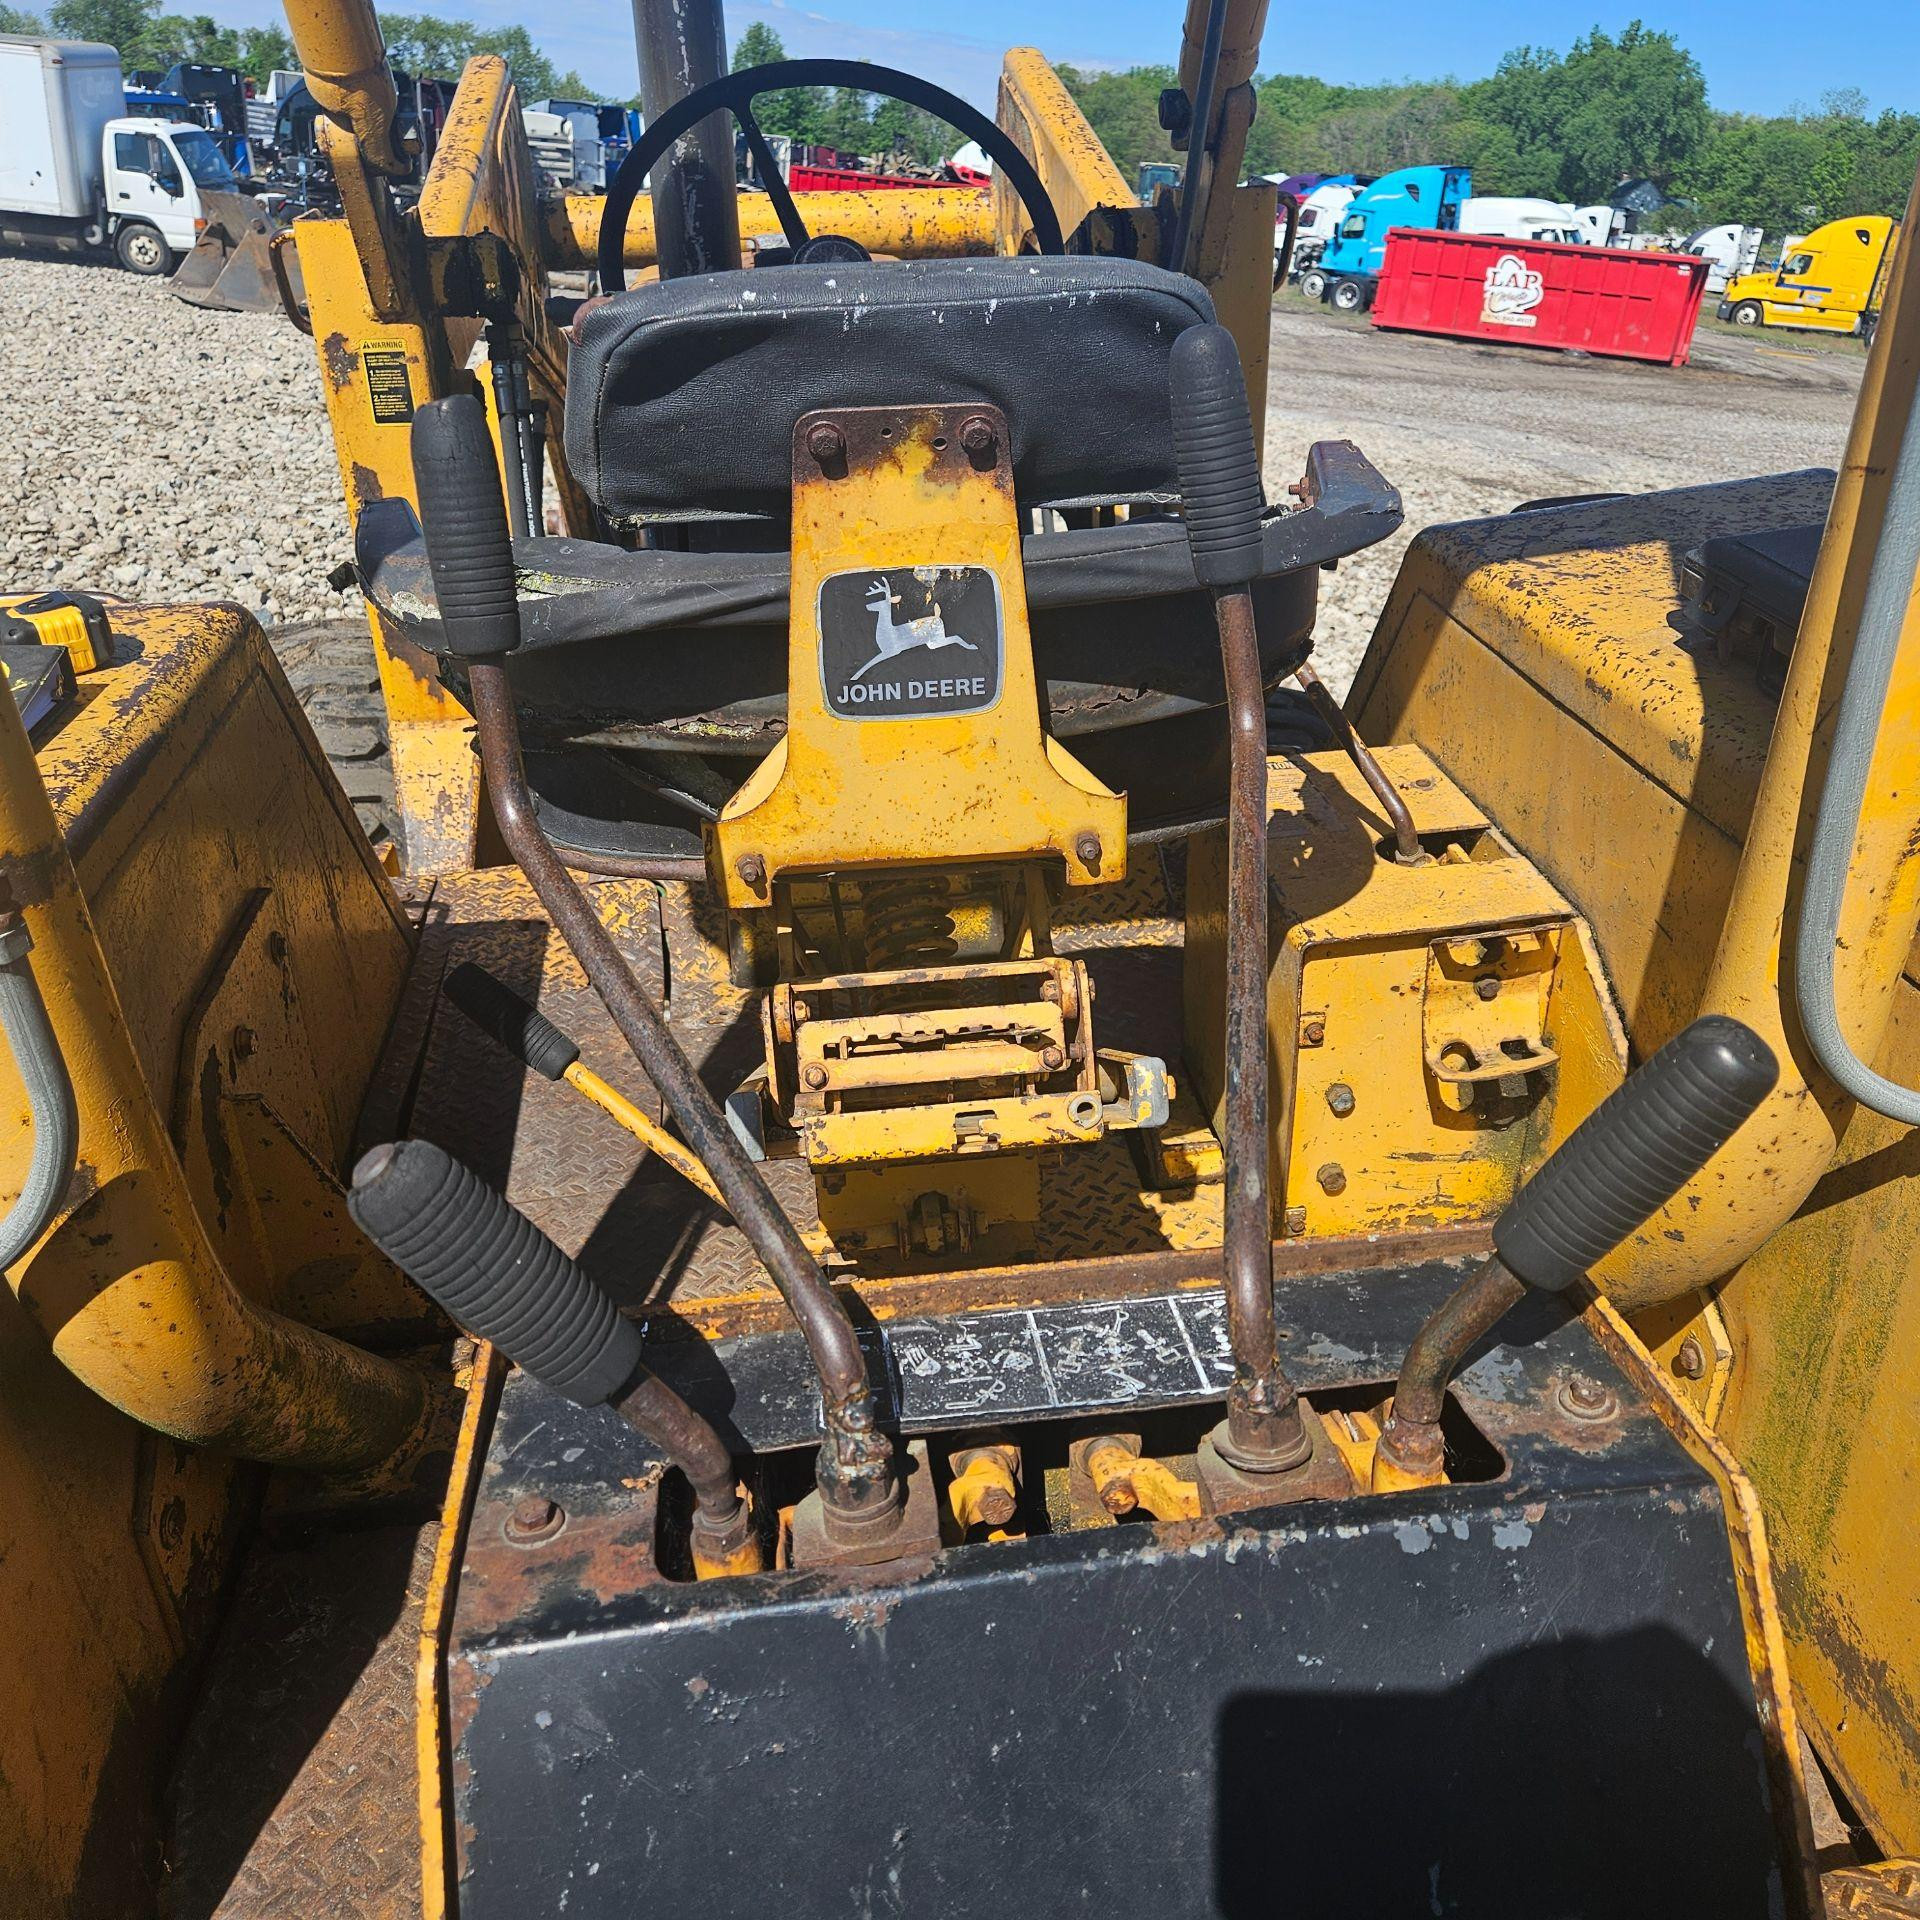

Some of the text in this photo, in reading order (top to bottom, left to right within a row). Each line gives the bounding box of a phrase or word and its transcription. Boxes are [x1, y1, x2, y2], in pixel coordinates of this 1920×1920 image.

[370, 341, 403, 349] WARNING
[836, 677, 986, 704] JOHN DEERE
[1266, 760, 1296, 770] TION
